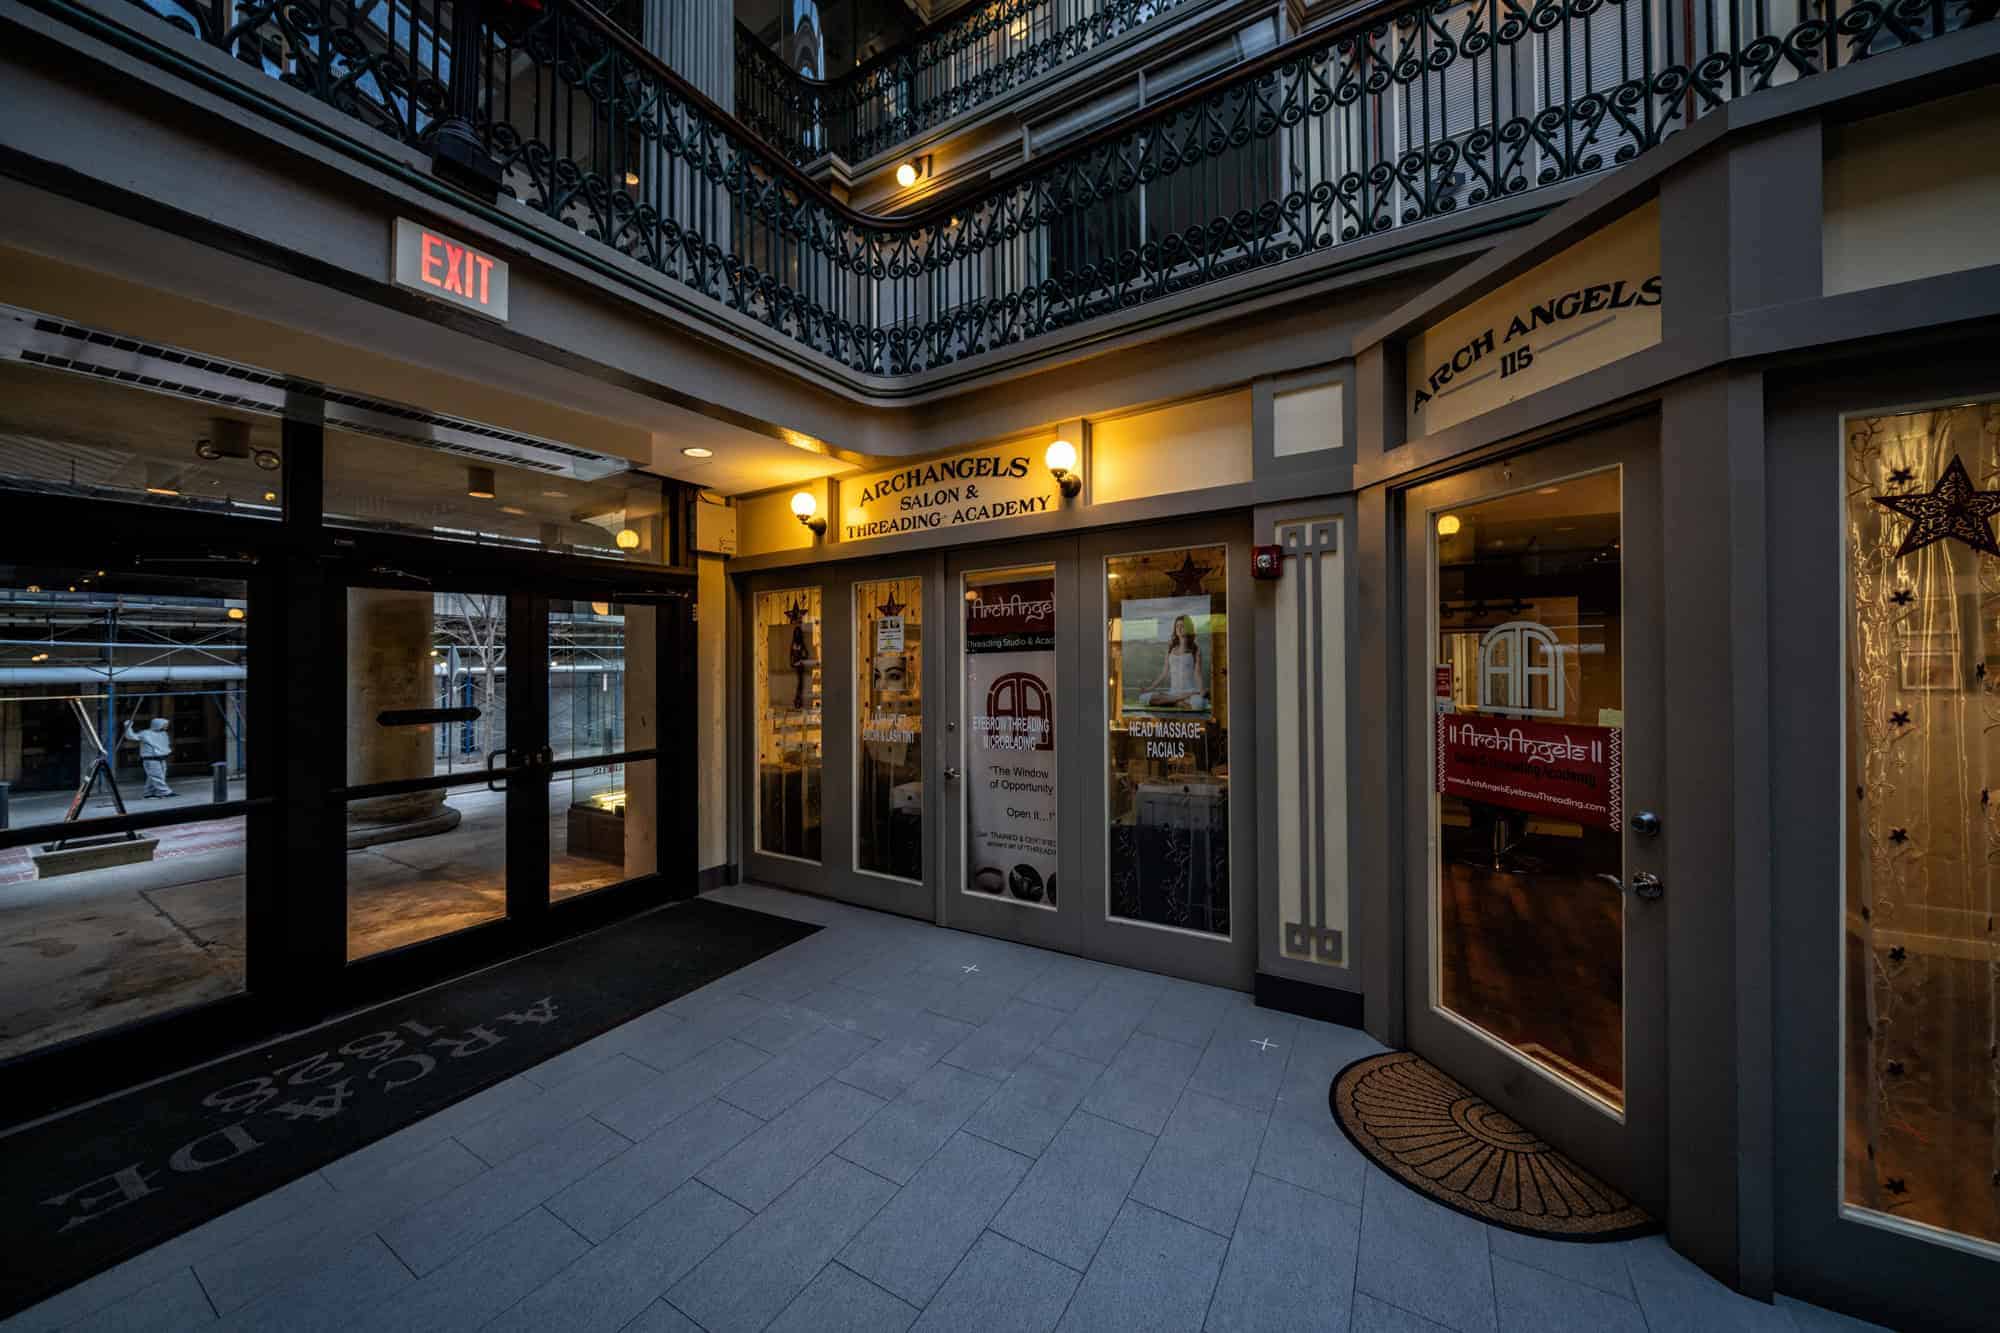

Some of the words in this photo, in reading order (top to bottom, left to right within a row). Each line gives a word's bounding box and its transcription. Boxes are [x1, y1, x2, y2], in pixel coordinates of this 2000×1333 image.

[421, 231, 495, 305] EXIT
[1412, 328, 1496, 414] ARCH
[1502, 275, 1663, 344] ANGELS
[1499, 344, 1534, 379] 115
[860, 456, 1031, 508] ARCHANGELS
[900, 487, 960, 512] SALON
[965, 483, 980, 499] &
[846, 511, 942, 539] THREADING
[951, 495, 1052, 525] ACADEMY
[1129, 720, 1153, 737] HEAD
[1154, 721, 1201, 739] MASSAGE
[1146, 741, 1185, 759] FACIALS
[1459, 723, 1589, 764] ArchAngels
[1012, 766, 1049, 779] Window
[1006, 807, 1031, 820] Open
[200, 1020, 445, 1116] 1828
[39, 996, 560, 1233] ARCADE
